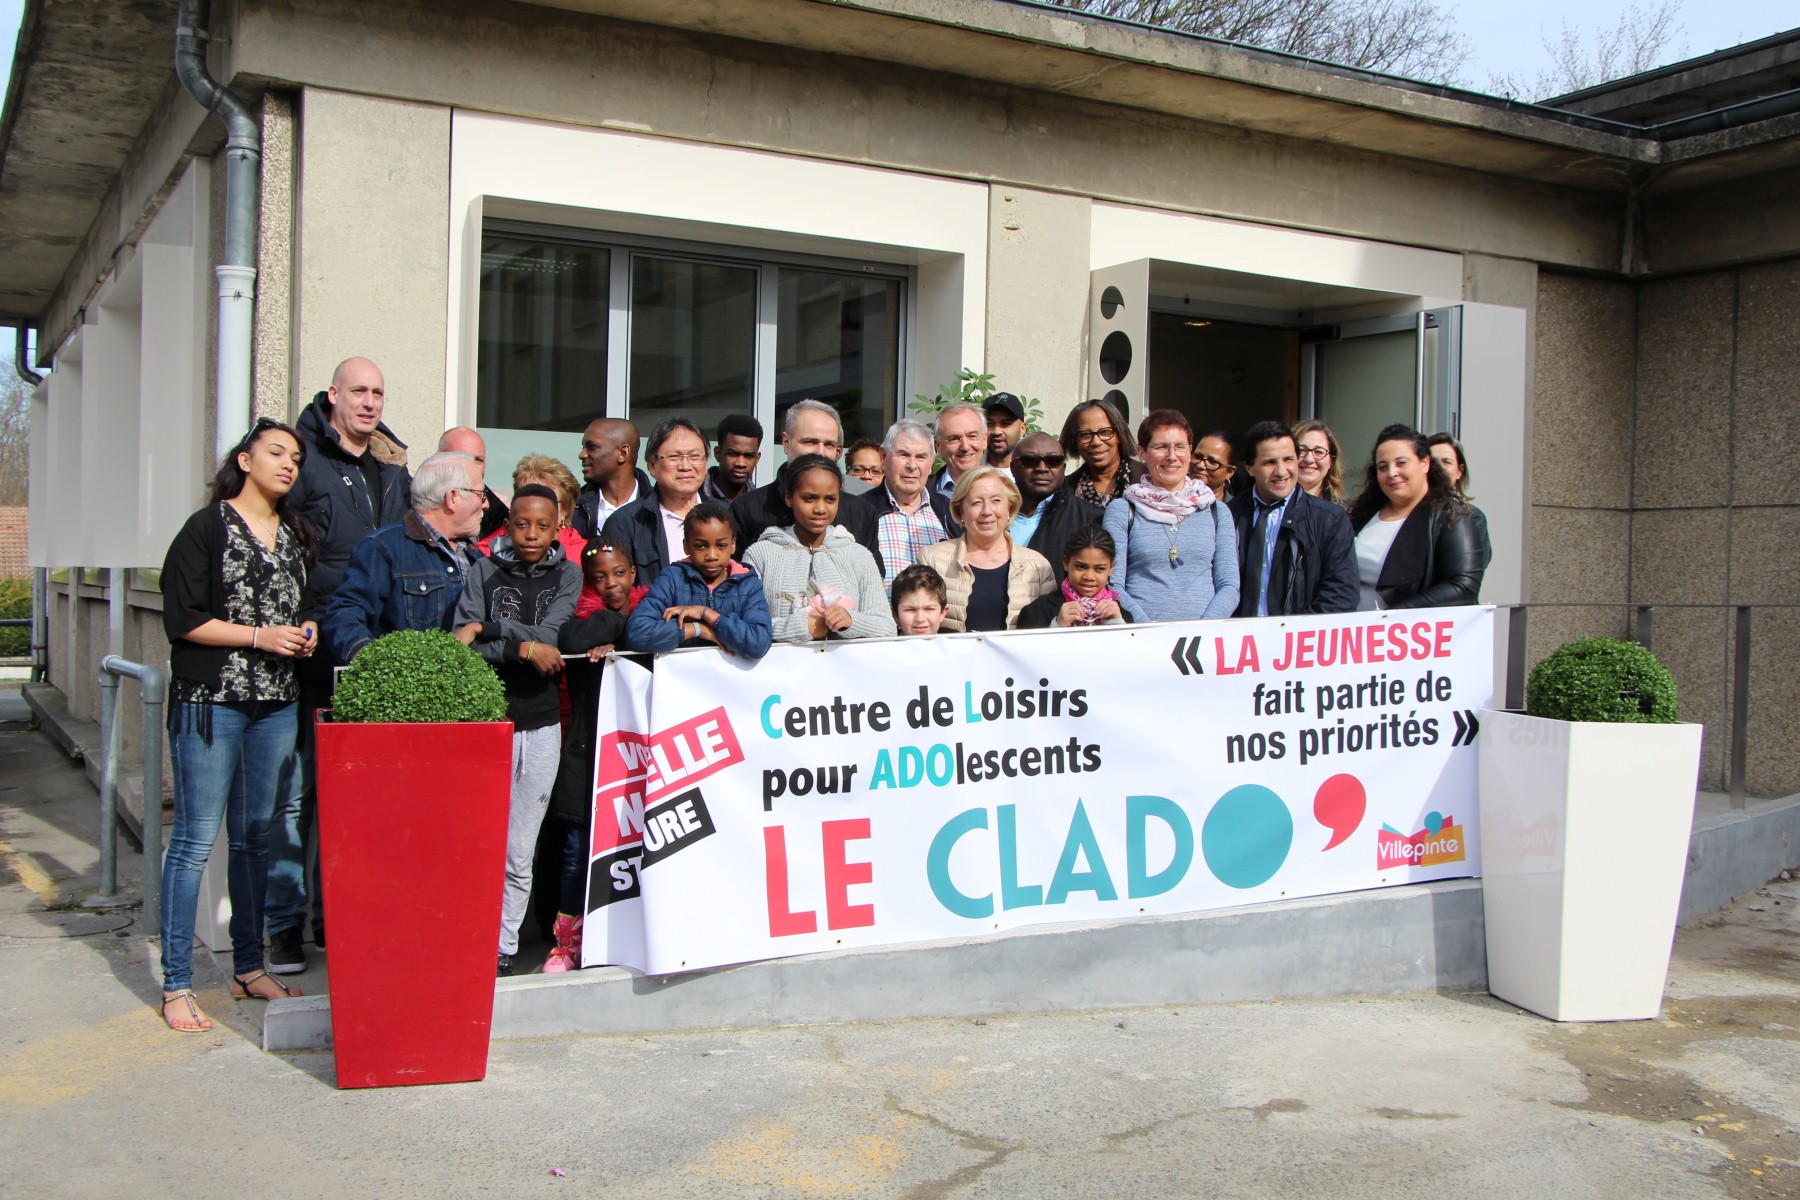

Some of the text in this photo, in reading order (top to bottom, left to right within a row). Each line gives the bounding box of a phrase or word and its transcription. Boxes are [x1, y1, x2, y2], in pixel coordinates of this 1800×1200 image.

[1214, 635, 1261, 675] LA
[1273, 621, 1454, 671] JEUNESSE
[760, 677, 1088, 739] Centre de Loisirs
[1253, 670, 1453, 719] fait partie de
[1226, 730, 1286, 763] nos
[1299, 710, 1439, 765] priorités
[762, 736, 1102, 811] pour ADOlescents
[763, 817, 875, 938] LE
[1379, 838, 1459, 862] Villepinte
